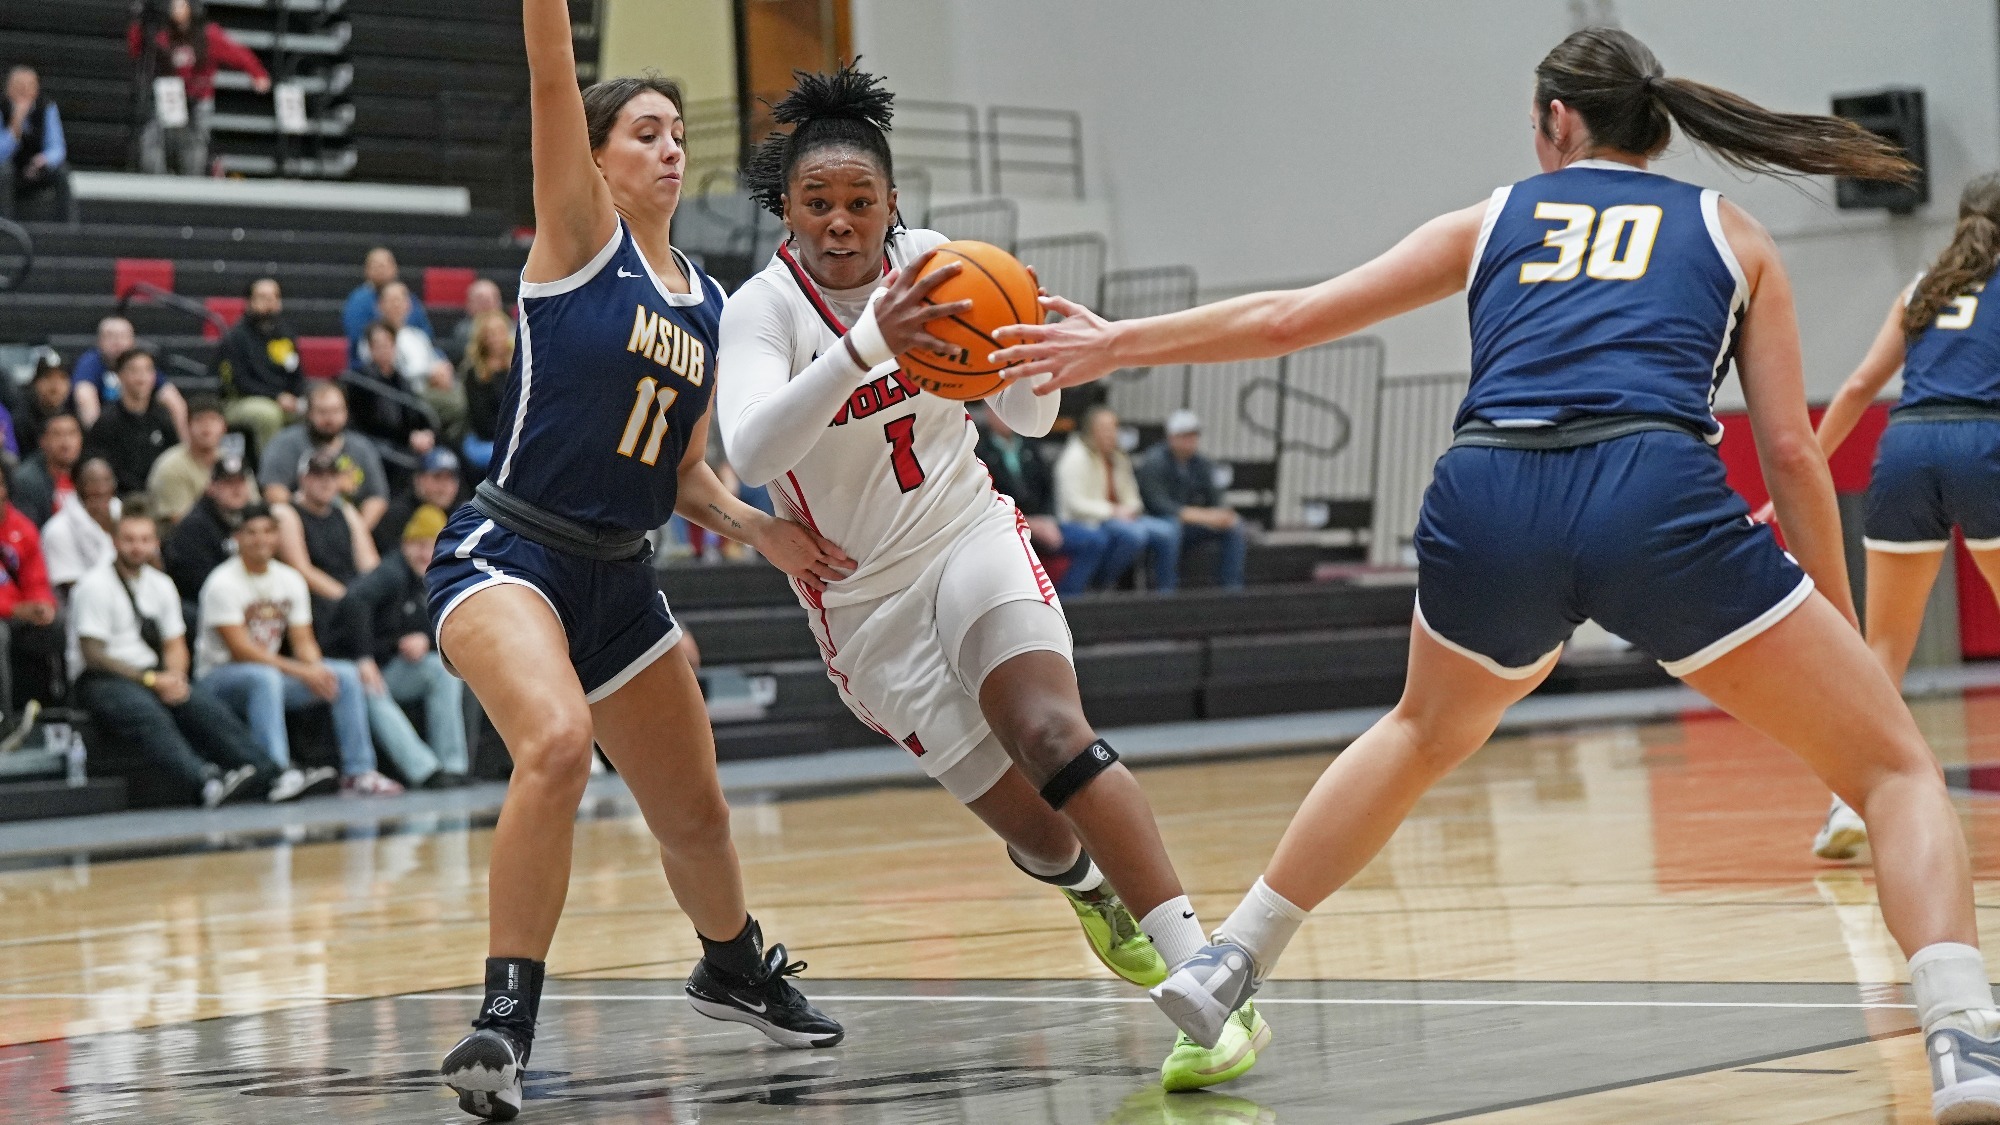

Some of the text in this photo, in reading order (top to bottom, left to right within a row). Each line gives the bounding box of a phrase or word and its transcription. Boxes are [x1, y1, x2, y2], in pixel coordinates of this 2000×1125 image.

[1519, 202, 1663, 284] 30
[627, 304, 705, 387] MSUB
[617, 376, 678, 467] 11
[884, 413, 925, 494] 1
